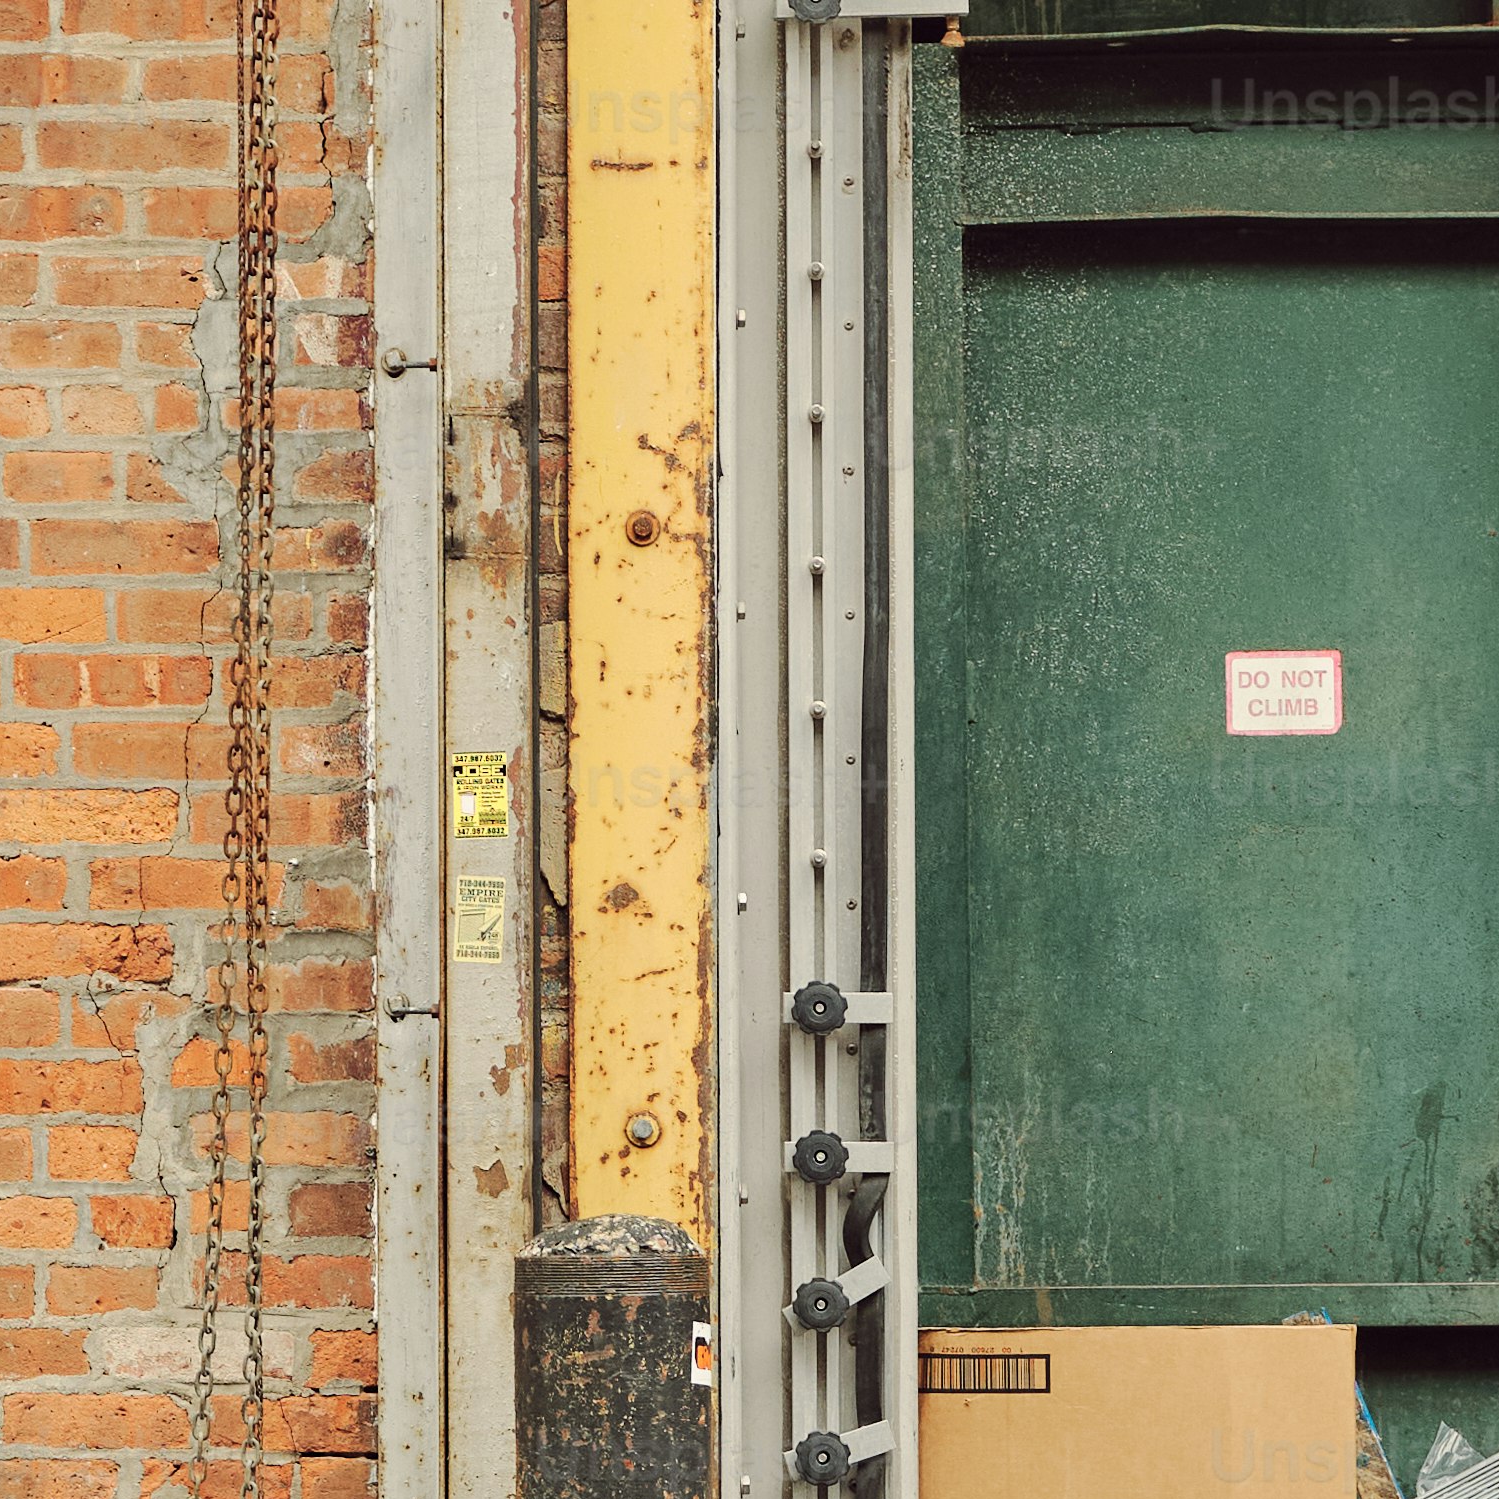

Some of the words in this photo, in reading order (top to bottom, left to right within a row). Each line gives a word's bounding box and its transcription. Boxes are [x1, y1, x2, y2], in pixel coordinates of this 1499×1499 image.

[1238, 671, 1270, 689] DO
[1282, 670, 1327, 688] NOT
[1248, 698, 1319, 717] CLIMB
[455, 765, 504, 777] JOSE
[459, 888, 504, 898] EMPIRE
